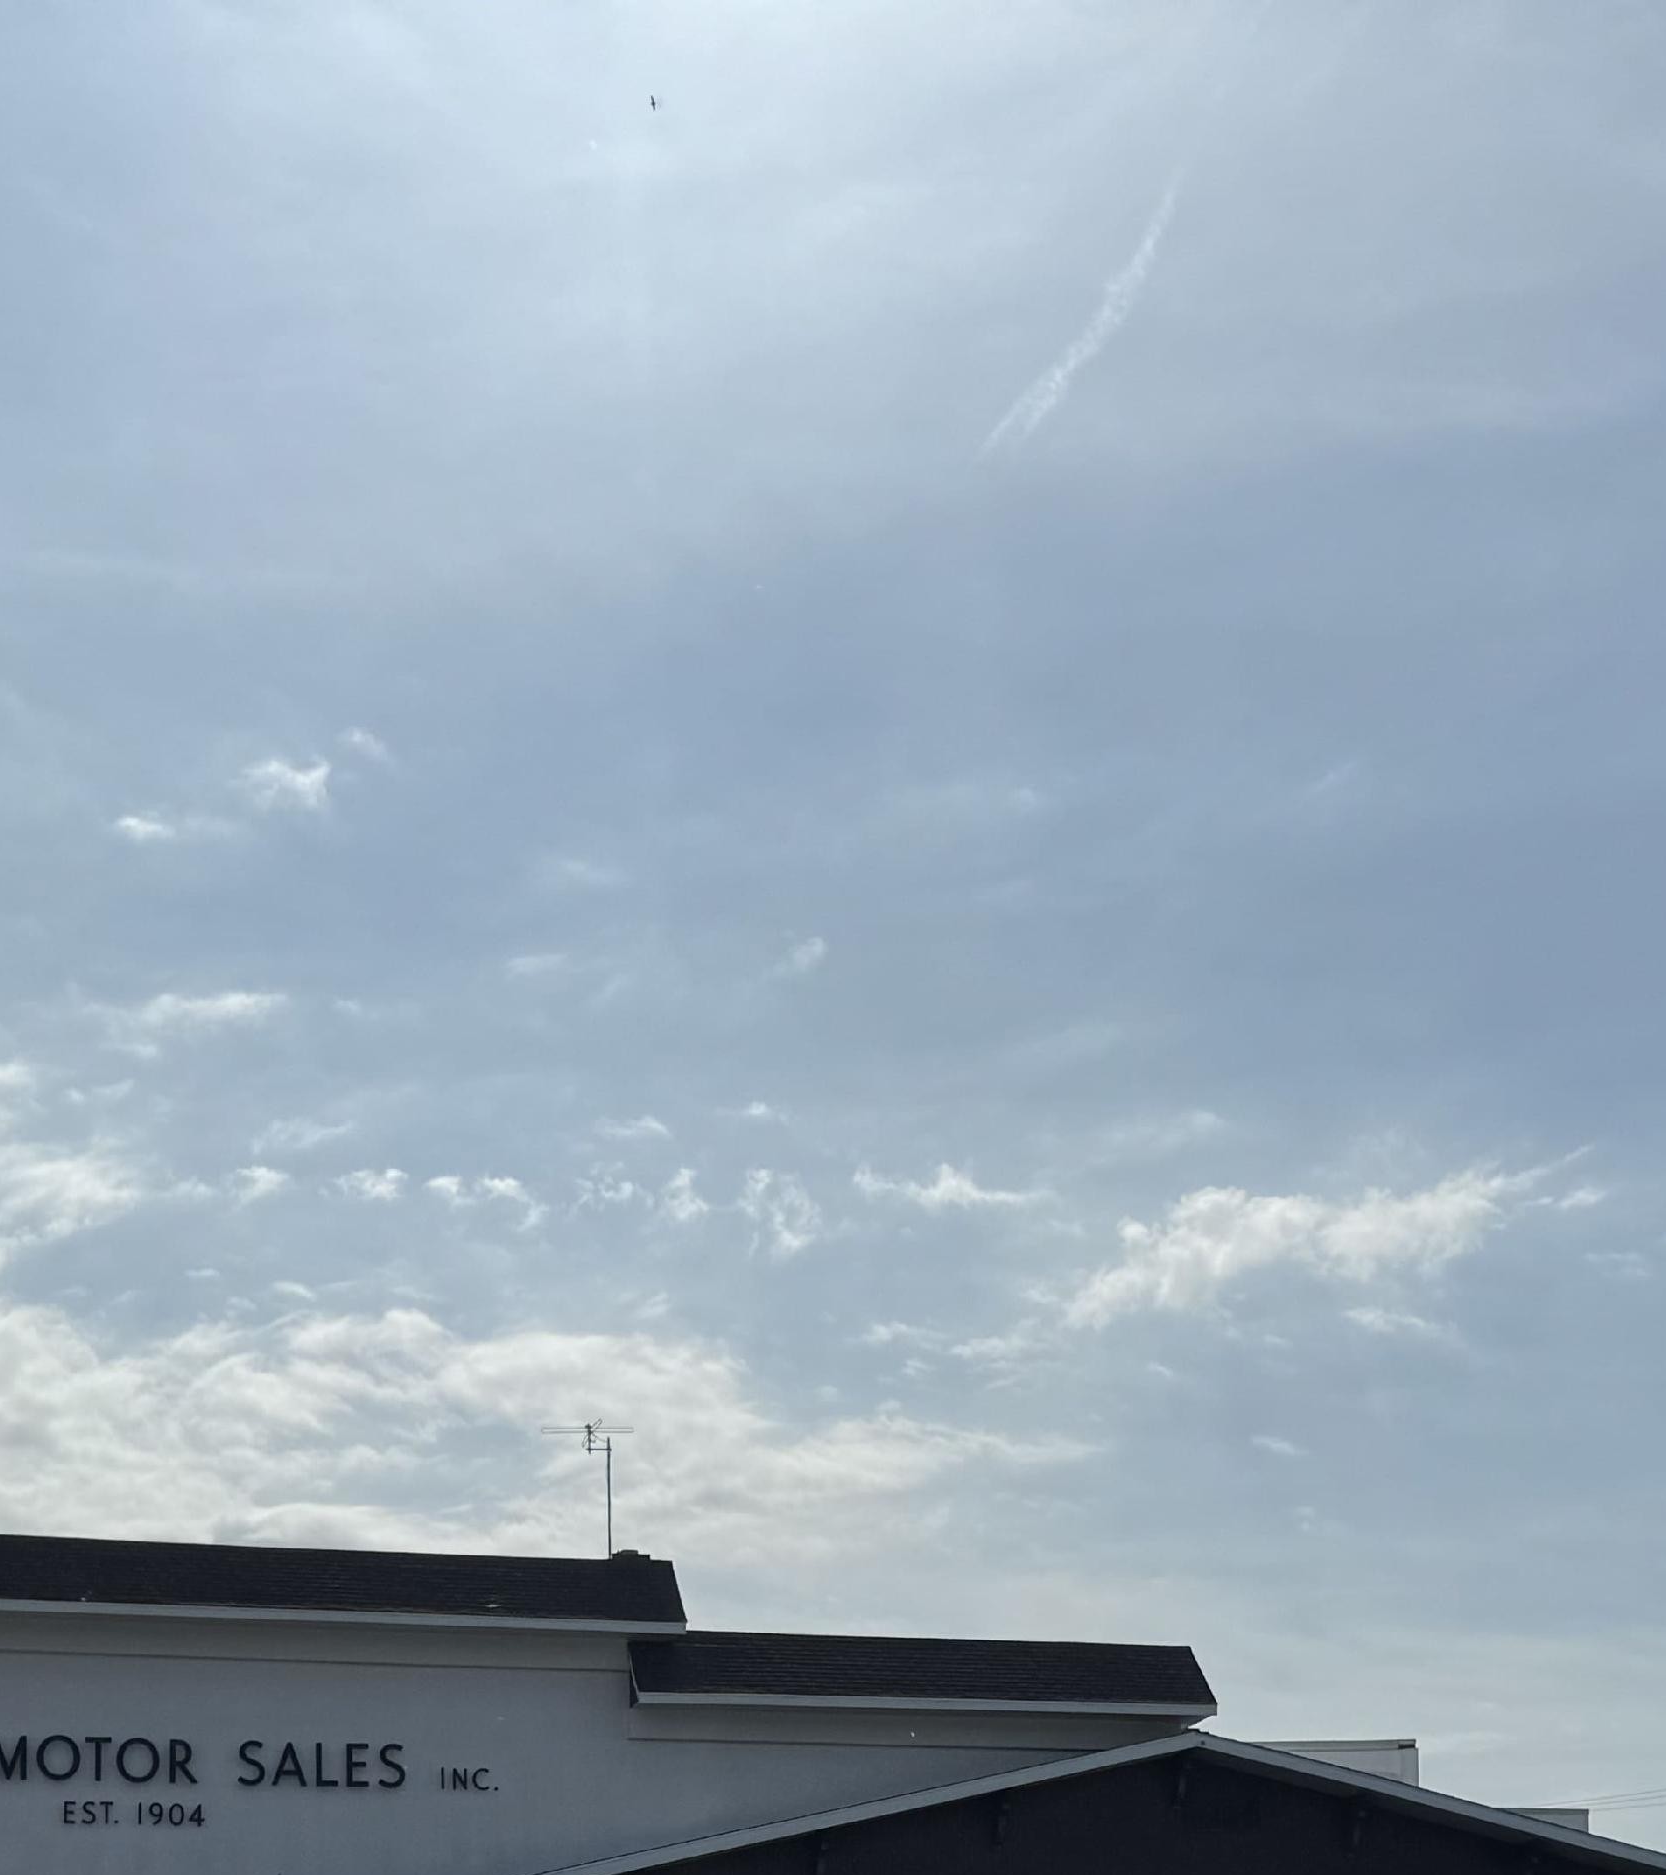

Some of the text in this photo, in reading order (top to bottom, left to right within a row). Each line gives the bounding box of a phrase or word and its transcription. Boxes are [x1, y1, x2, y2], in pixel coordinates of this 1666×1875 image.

[237, 1740, 407, 1789] SALES
[440, 1766, 500, 1792] INC.
[62, 1800, 206, 1828] EST. 1904
